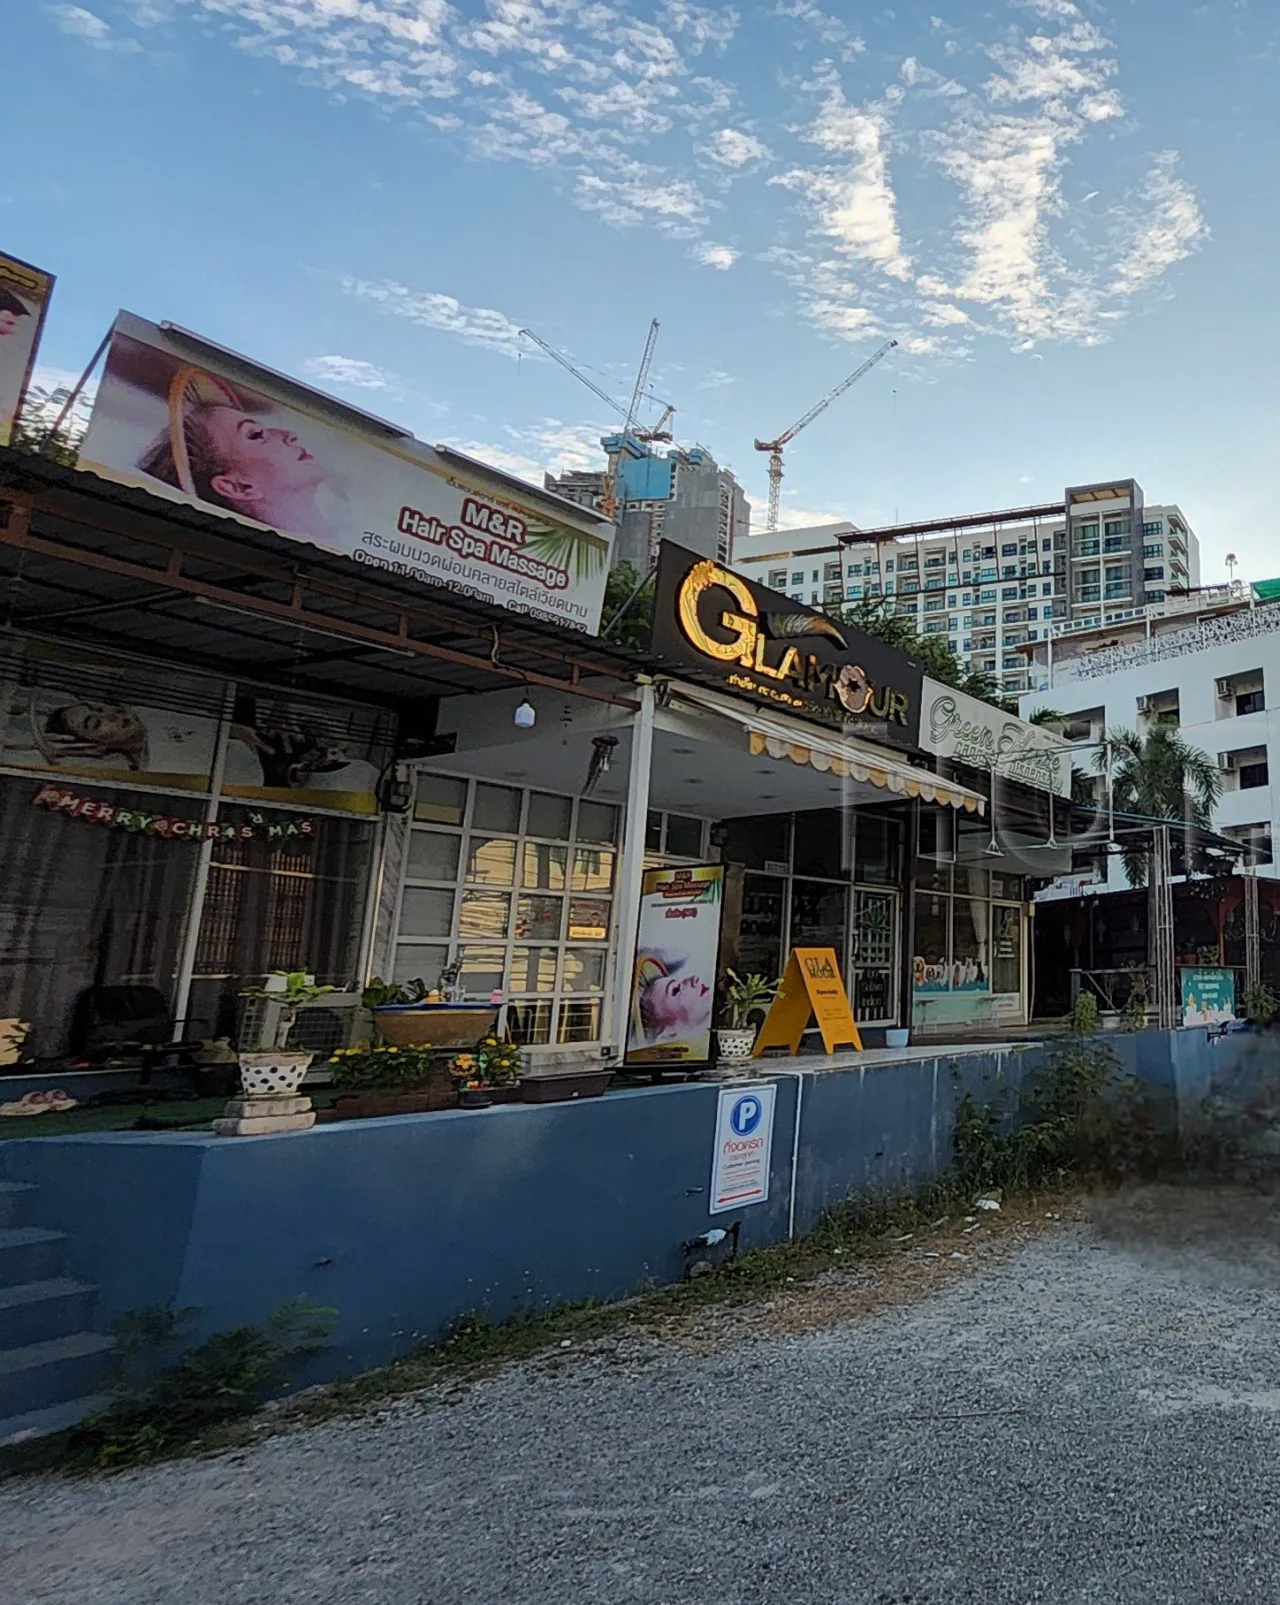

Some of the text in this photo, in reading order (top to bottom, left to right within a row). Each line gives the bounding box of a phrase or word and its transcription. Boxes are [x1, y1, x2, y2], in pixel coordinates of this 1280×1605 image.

[465, 501, 525, 543] M&R
[401, 510, 567, 586] Hair Spa Massage
[930, 695, 995, 751] Green
[58, 795, 152, 829] MERRY
[738, 1101, 757, 1131] P
